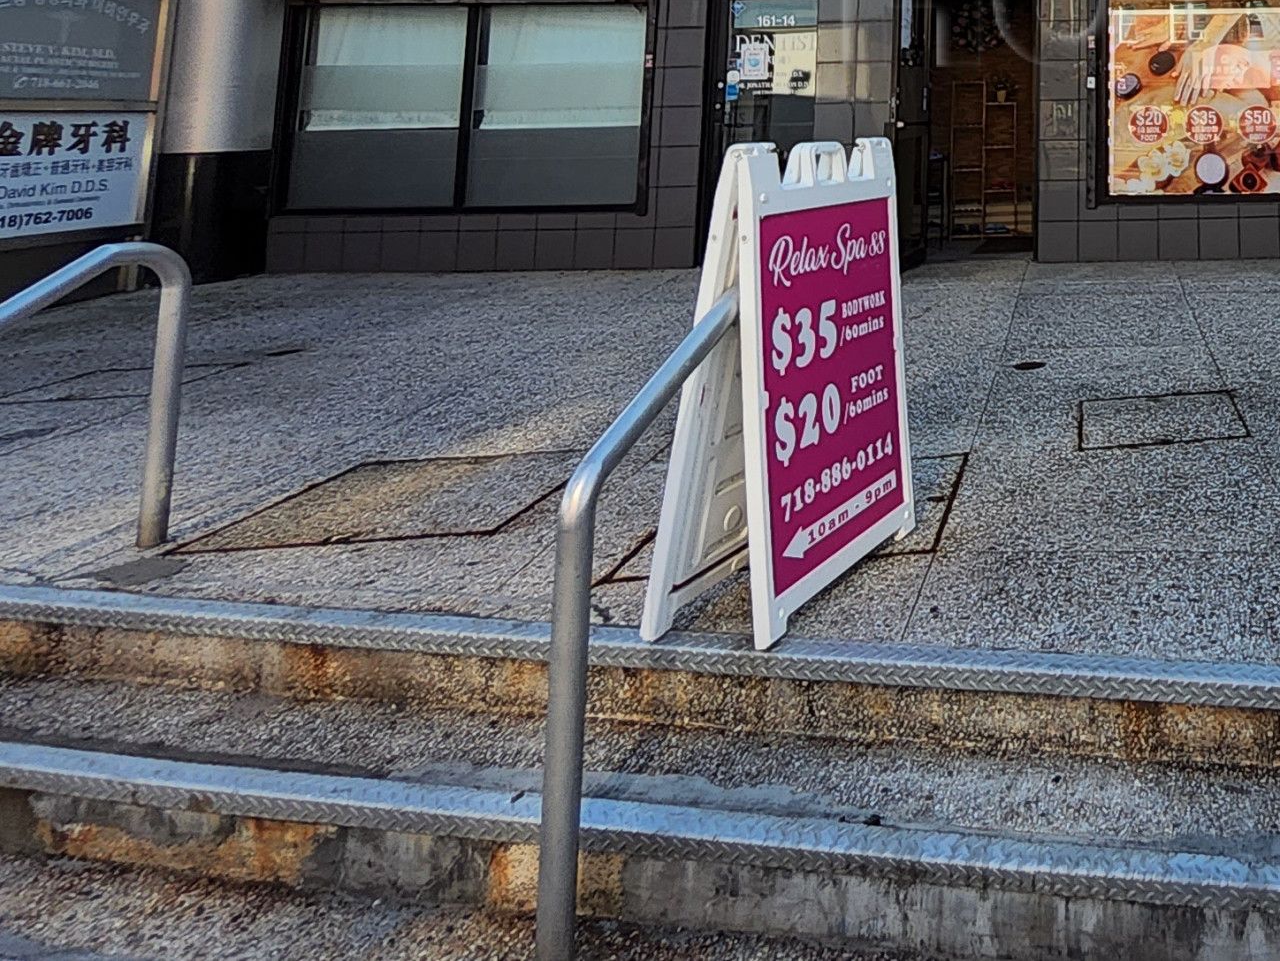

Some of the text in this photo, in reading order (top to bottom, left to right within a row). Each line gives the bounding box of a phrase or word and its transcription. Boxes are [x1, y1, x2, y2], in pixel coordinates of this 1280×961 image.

[757, 14, 795, 27] 161-14
[1135, 111, 1163, 127] $20
[1190, 110, 1217, 126] $35
[1244, 109, 1271, 125] $50
[40, 182, 67, 196] Kim
[769, 223, 886, 287] Relax Spa 88
[772, 299, 838, 376] $35
[839, 316, 884, 347] /60mins
[851, 364, 884, 393] FOOT
[843, 387, 889, 425] /60mins
[775, 383, 841, 467] $20
[781, 431, 893, 523] 718-886-0114
[807, 508, 849, 545] 10am
[865, 478, 892, 503] 9pm
